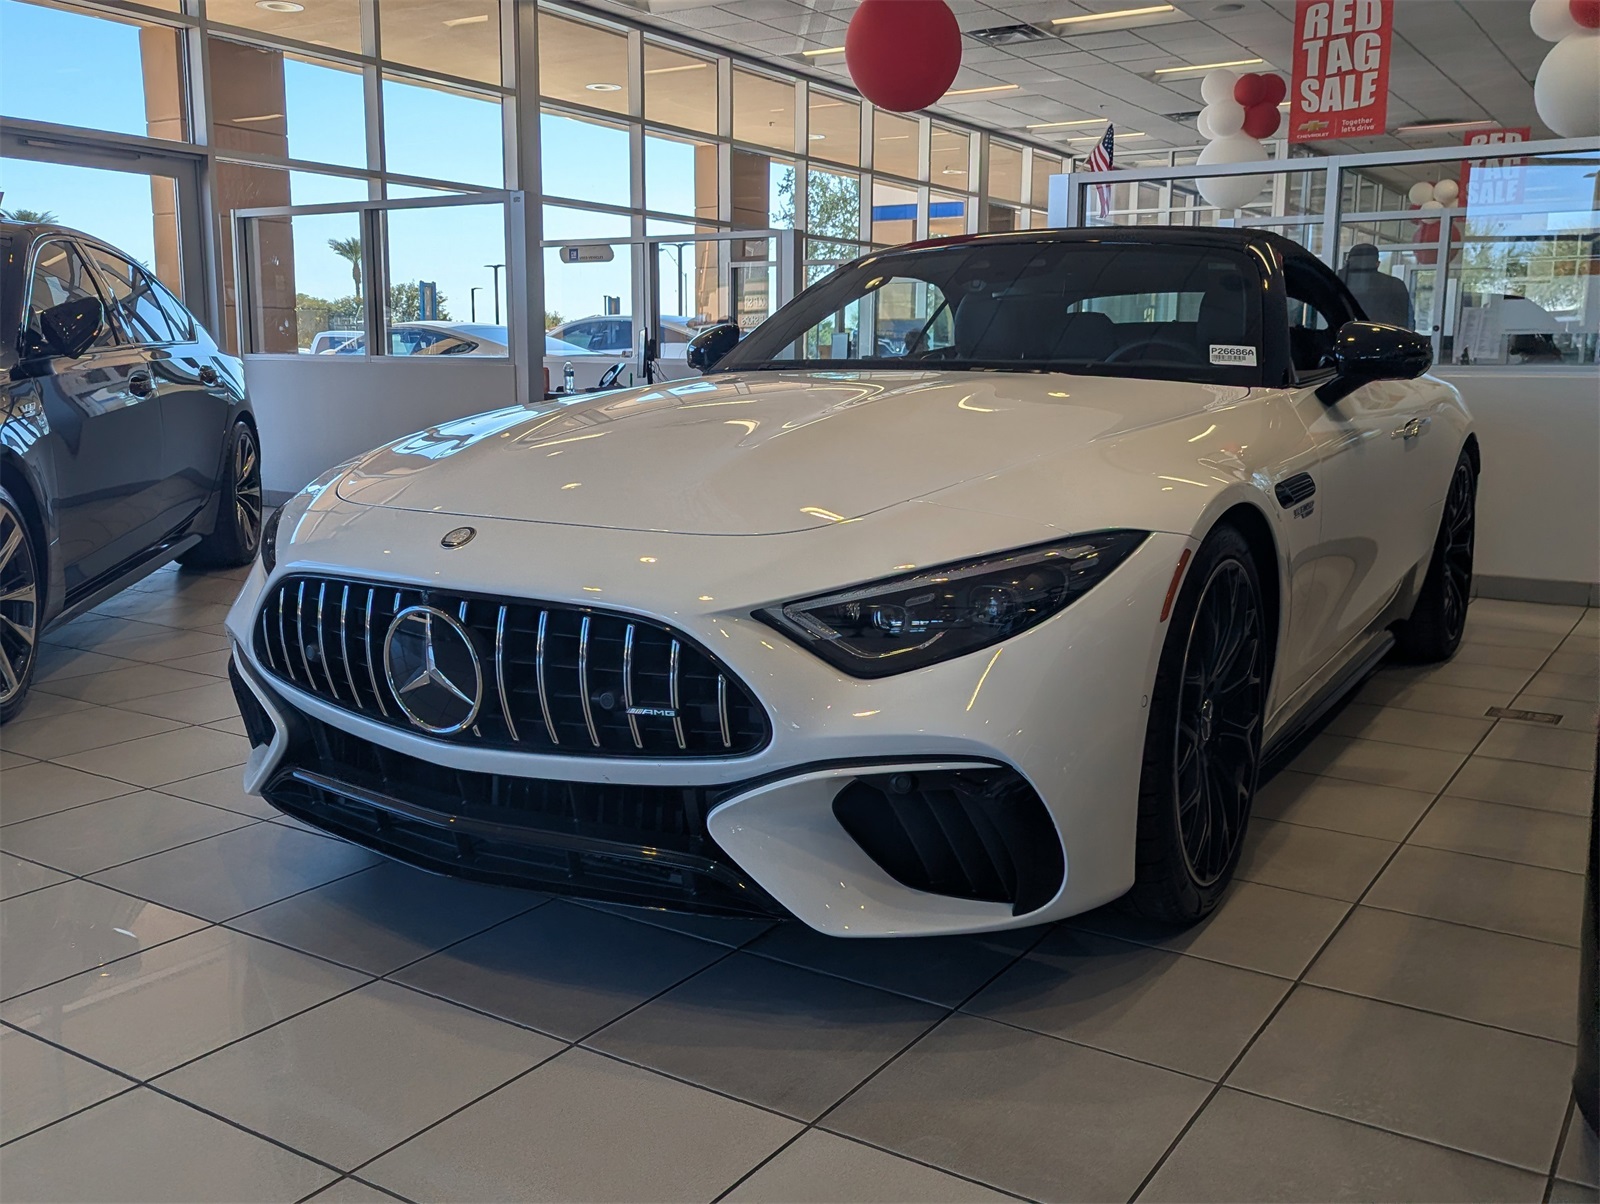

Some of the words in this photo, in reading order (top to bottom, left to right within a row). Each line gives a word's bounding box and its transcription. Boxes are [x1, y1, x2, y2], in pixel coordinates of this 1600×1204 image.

[1303, 0, 1382, 40] RED
[1302, 32, 1382, 77] TAG
[1300, 71, 1378, 113] SALE
[1341, 118, 1373, 127] Together
[1356, 124, 1375, 132] drive
[1467, 180, 1519, 204] SALE
[1211, 347, 1254, 356] P26686A
